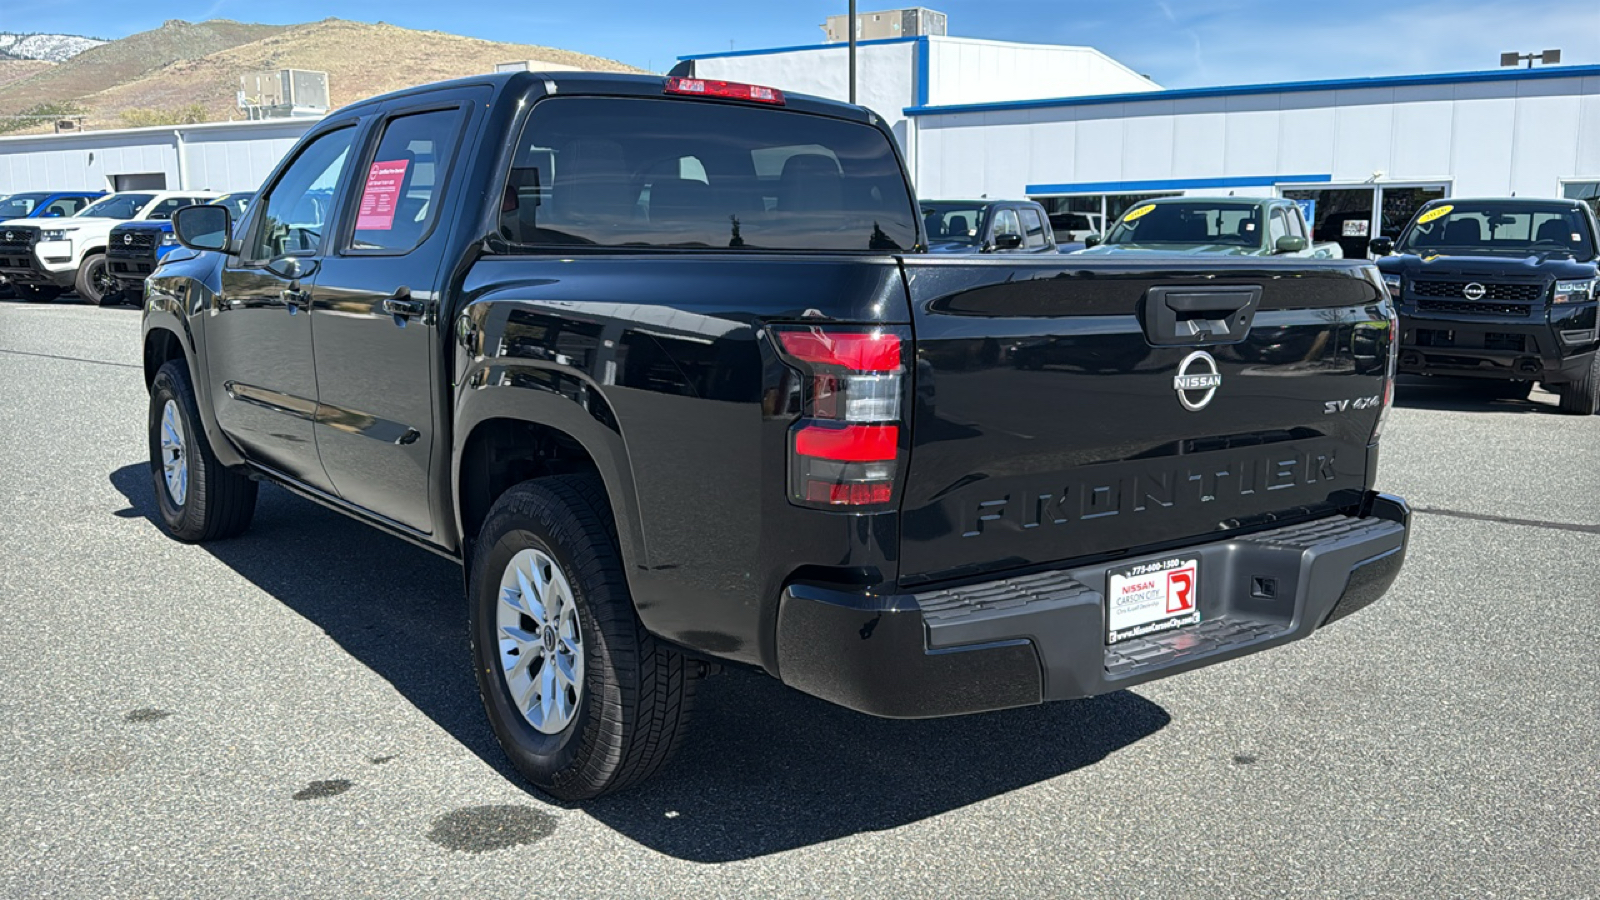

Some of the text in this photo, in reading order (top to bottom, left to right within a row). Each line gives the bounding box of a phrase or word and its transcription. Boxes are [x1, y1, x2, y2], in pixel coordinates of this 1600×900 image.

[1175, 374, 1221, 388] NISSAN
[1324, 400, 1349, 414] SV
[961, 454, 1337, 537] FRONTIER
[1132, 558, 1179, 575] 775-600-1500
[1122, 581, 1155, 594] NISSAN
[1171, 574, 1193, 609] R
[1116, 589, 1160, 605] CARSON CITY
